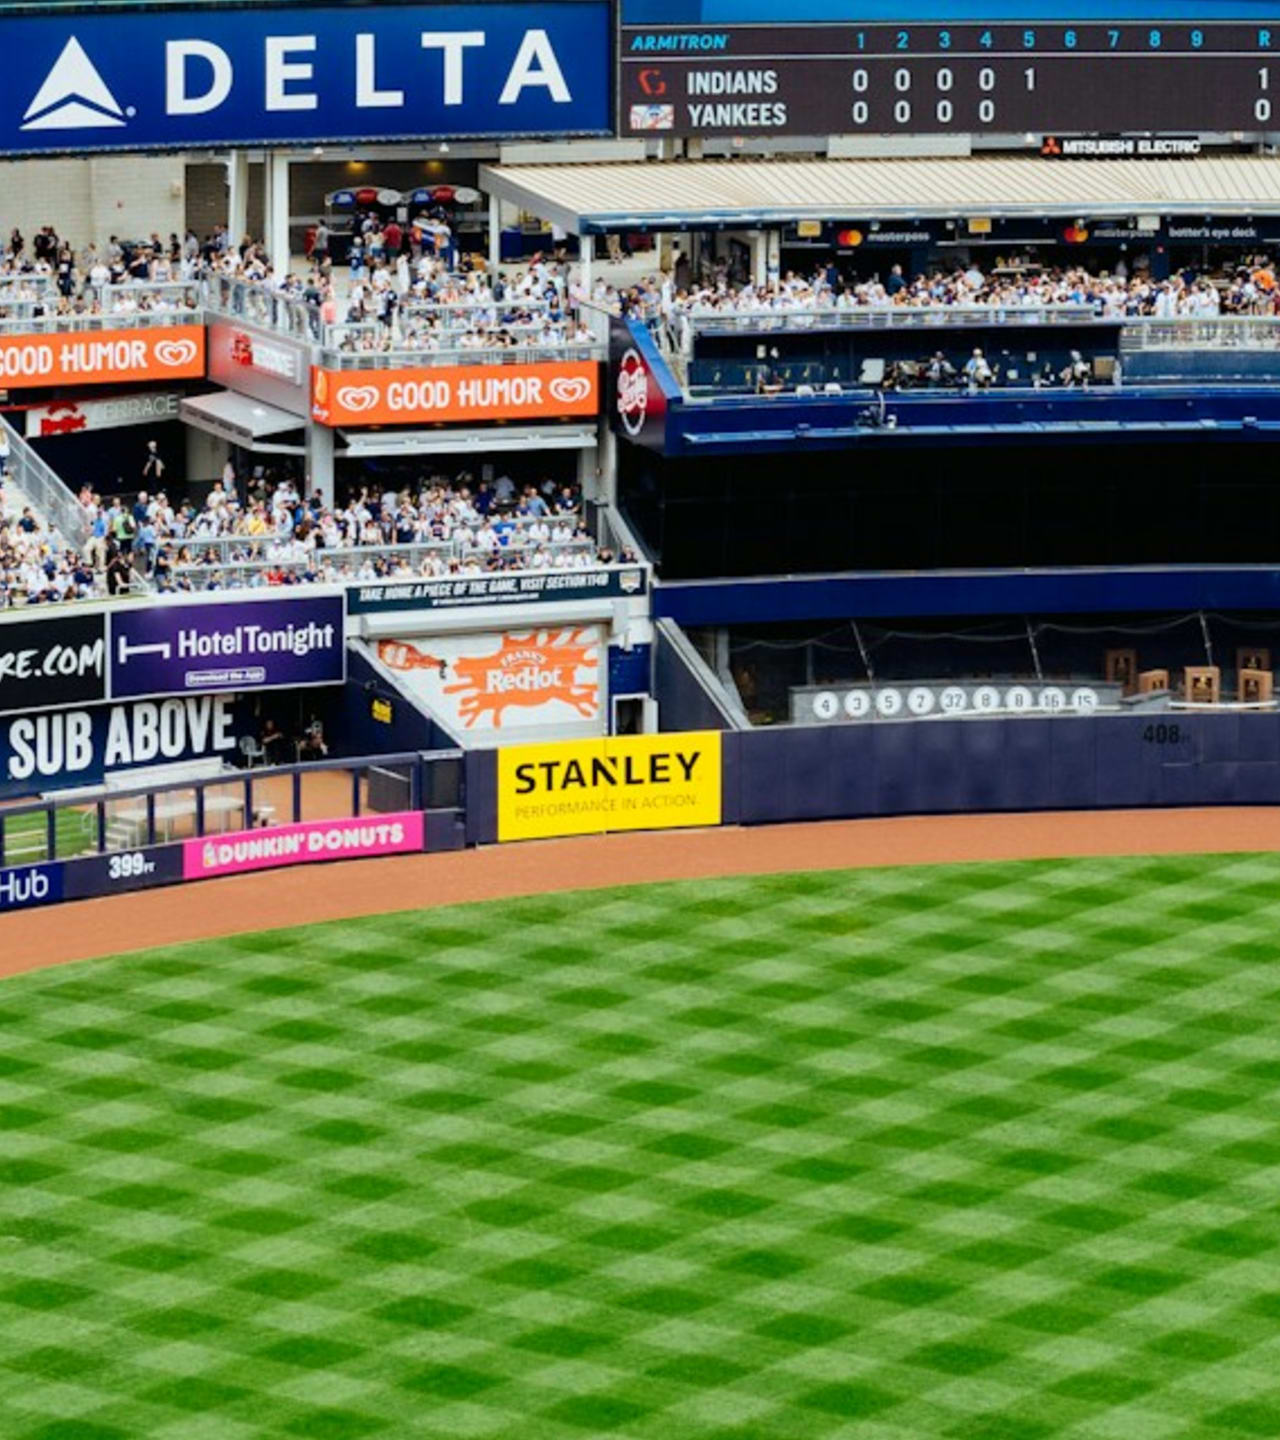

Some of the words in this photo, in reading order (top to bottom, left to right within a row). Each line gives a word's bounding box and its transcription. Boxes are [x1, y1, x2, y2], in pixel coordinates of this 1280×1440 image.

[631, 34, 728, 51] ARMITRON
[165, 29, 572, 116] DELTA
[687, 70, 777, 94] INDIANS
[687, 102, 787, 127] YANKEES
[1063, 139, 1134, 154] MITSUBISHI
[1138, 139, 1201, 154] ELECTRIC
[60, 339, 148, 373] HUMOR
[387, 382, 449, 410] GOOD
[457, 377, 542, 407] HUMOR
[8, 712, 94, 779] SUB
[105, 695, 237, 765] ABOVE
[515, 752, 700, 794] STANLEY
[515, 799, 616, 819] PERFORMANCE
[622, 797, 636, 810] IN
[219, 834, 305, 865] DUNKIN'
[309, 824, 404, 852] DONUTS
